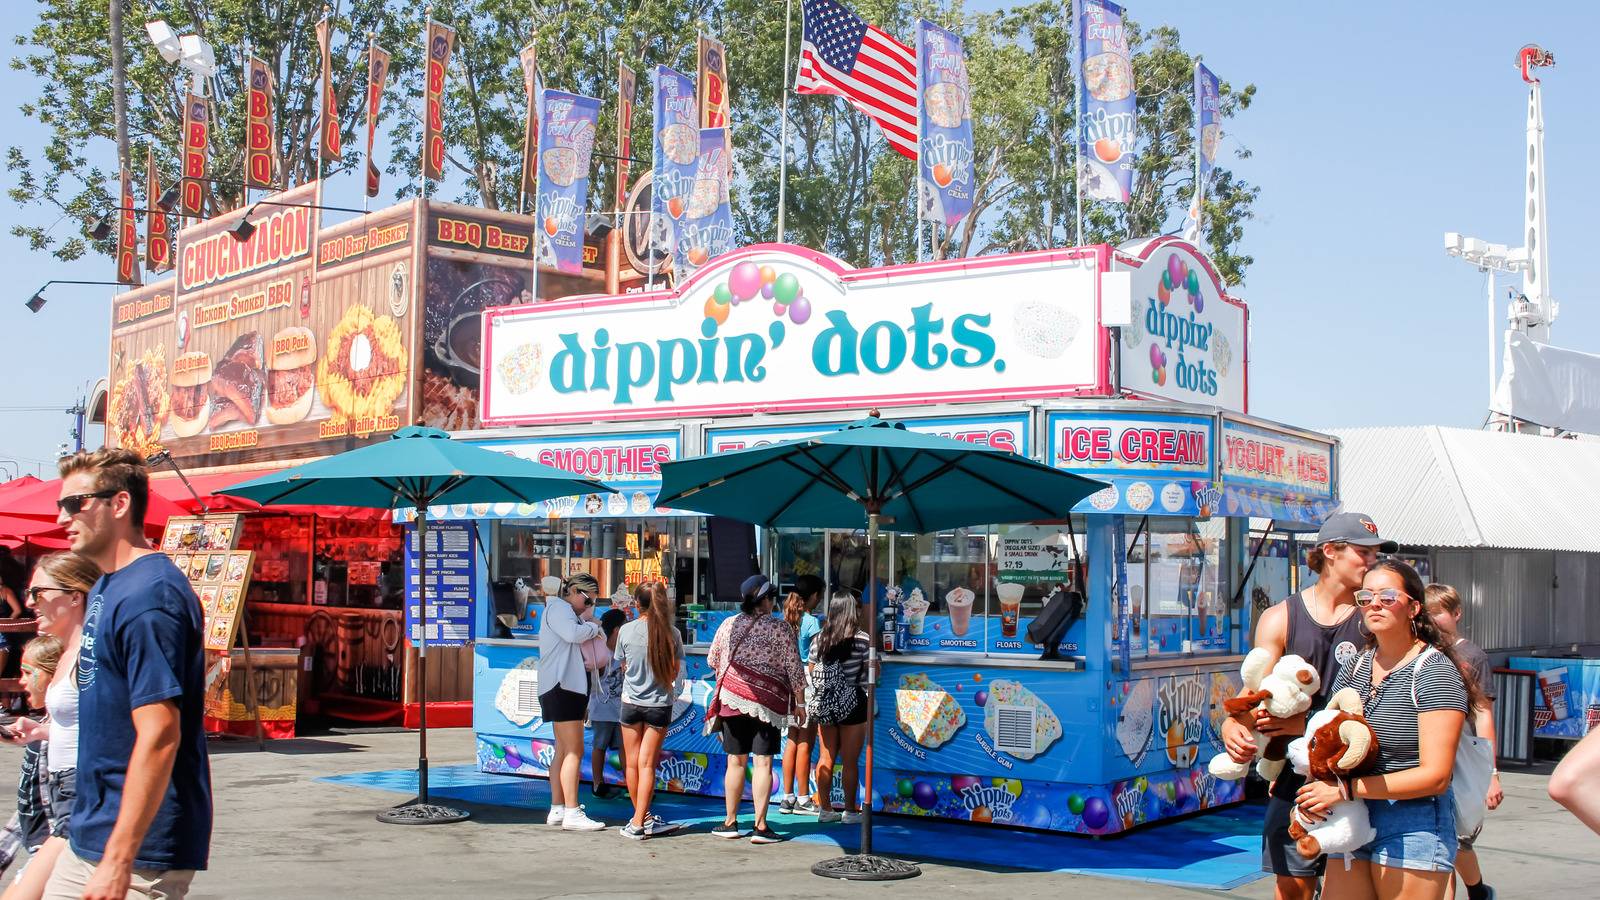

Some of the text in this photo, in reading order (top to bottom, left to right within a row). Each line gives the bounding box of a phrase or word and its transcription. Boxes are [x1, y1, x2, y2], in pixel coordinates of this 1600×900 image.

[930, 54, 961, 75] FUN!
[665, 97, 692, 118] FUN!
[250, 89, 271, 185] BBQ
[547, 119, 591, 141] FUN!
[185, 122, 207, 213] BBQ
[438, 218, 529, 253] BBQ BEEF
[556, 218, 577, 235] dots
[560, 233, 571, 241] ICE
[183, 203, 311, 290] CHUCKWAGON
[321, 223, 409, 264] BBQ BEEF BRISKET
[554, 239, 577, 248] CREAM
[118, 306, 135, 324] BBQ
[193, 279, 293, 328] HICKORY SMOKED BBQ
[1146, 297, 1213, 352] dippin'
[276, 333, 309, 355] BBQ Pork
[174, 353, 210, 373] BBQ Brisket
[549, 315, 786, 404] dippin'
[1176, 353, 1218, 396] dots
[320, 414, 399, 438] Brisket Waffle Fries
[210, 430, 258, 450] BBQ Pork RIBS
[1062, 427, 1205, 465] ICE CREAM
[538, 444, 671, 476] SMOOTHIES
[1225, 435, 1329, 484] YOGURT ICES
[1004, 560, 1023, 569] $7.19
[908, 638, 930, 646] NDAES
[940, 639, 977, 647] SMOOTHIES
[996, 641, 1022, 649] FLOATS
[683, 709, 697, 726] CANDY
[888, 727, 927, 760] RAINBOW ICE
[975, 733, 1013, 770] BUBBLE GUM
[661, 757, 703, 782] dippin'
[683, 776, 701, 791] dots
[960, 782, 1017, 811] dippin'
[991, 805, 1013, 821] dots
